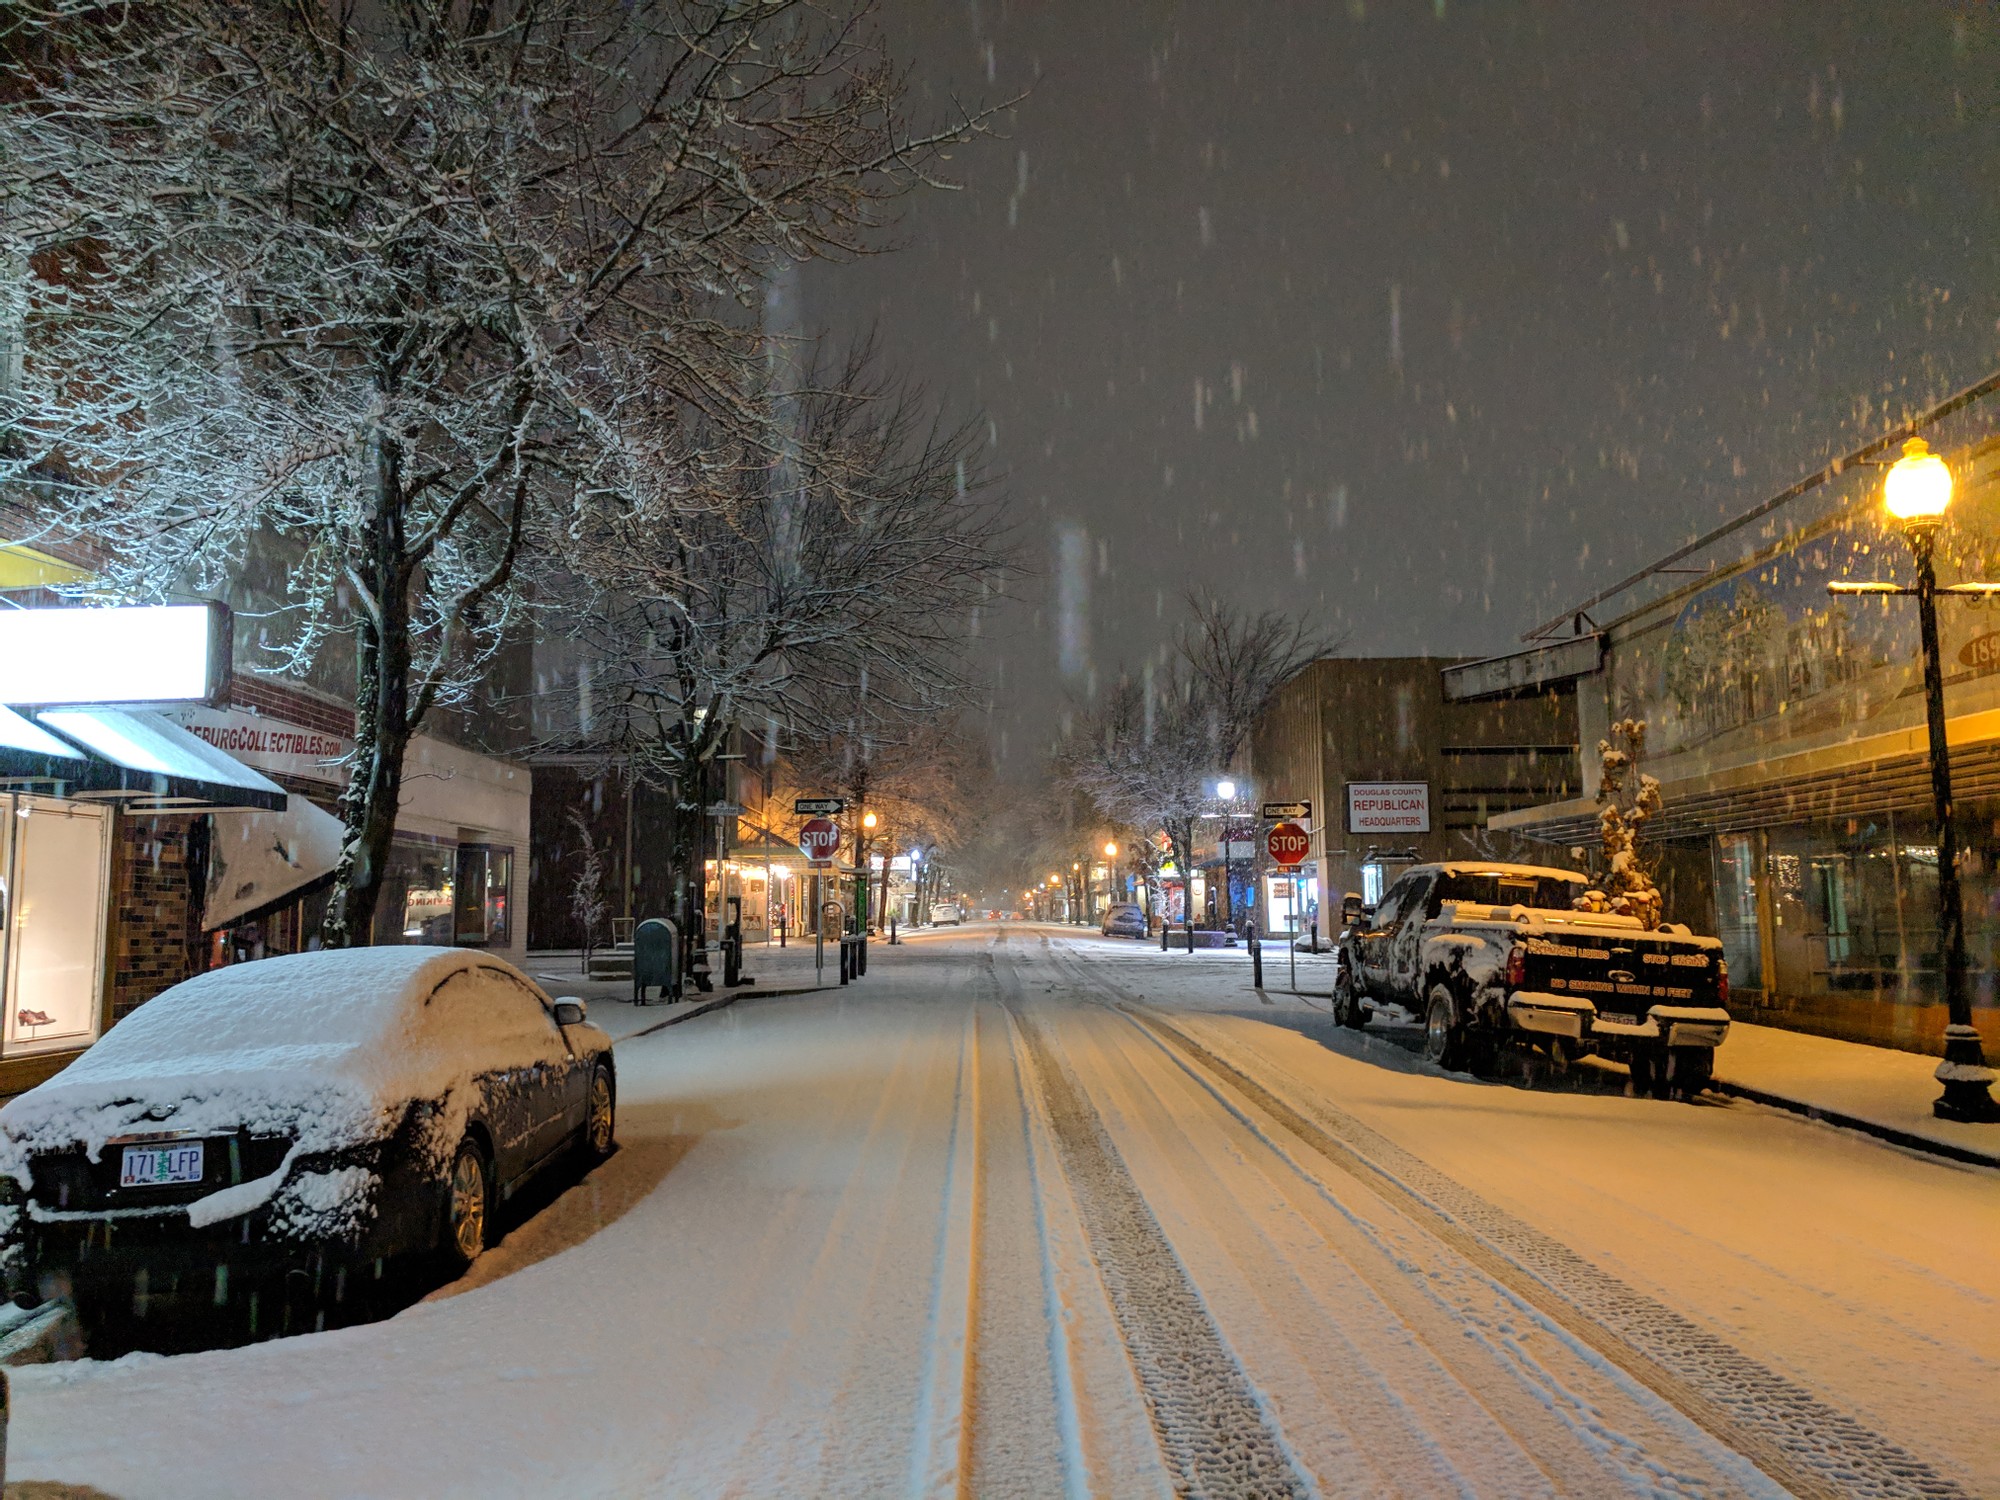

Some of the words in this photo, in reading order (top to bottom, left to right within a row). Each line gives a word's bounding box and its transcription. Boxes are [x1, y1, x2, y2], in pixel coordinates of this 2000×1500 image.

[1392, 788, 1422, 796] COUNTY
[1353, 800, 1425, 811] REPUBLICAN
[1359, 817, 1421, 826] HEADQUARTERS
[802, 831, 838, 847] STOP
[1270, 836, 1307, 852] STOP
[1578, 948, 1610, 960] LIQUIDS
[1643, 953, 1670, 964] STOP
[1551, 978, 1567, 988] NO
[1568, 980, 1614, 992] SMOKING
[1616, 983, 1650, 995] WITHIN
[1653, 986, 1666, 997] 50
[1667, 987, 1693, 998] FEET
[129, 1153, 155, 1176] 171
[168, 1151, 199, 1174] LFP
